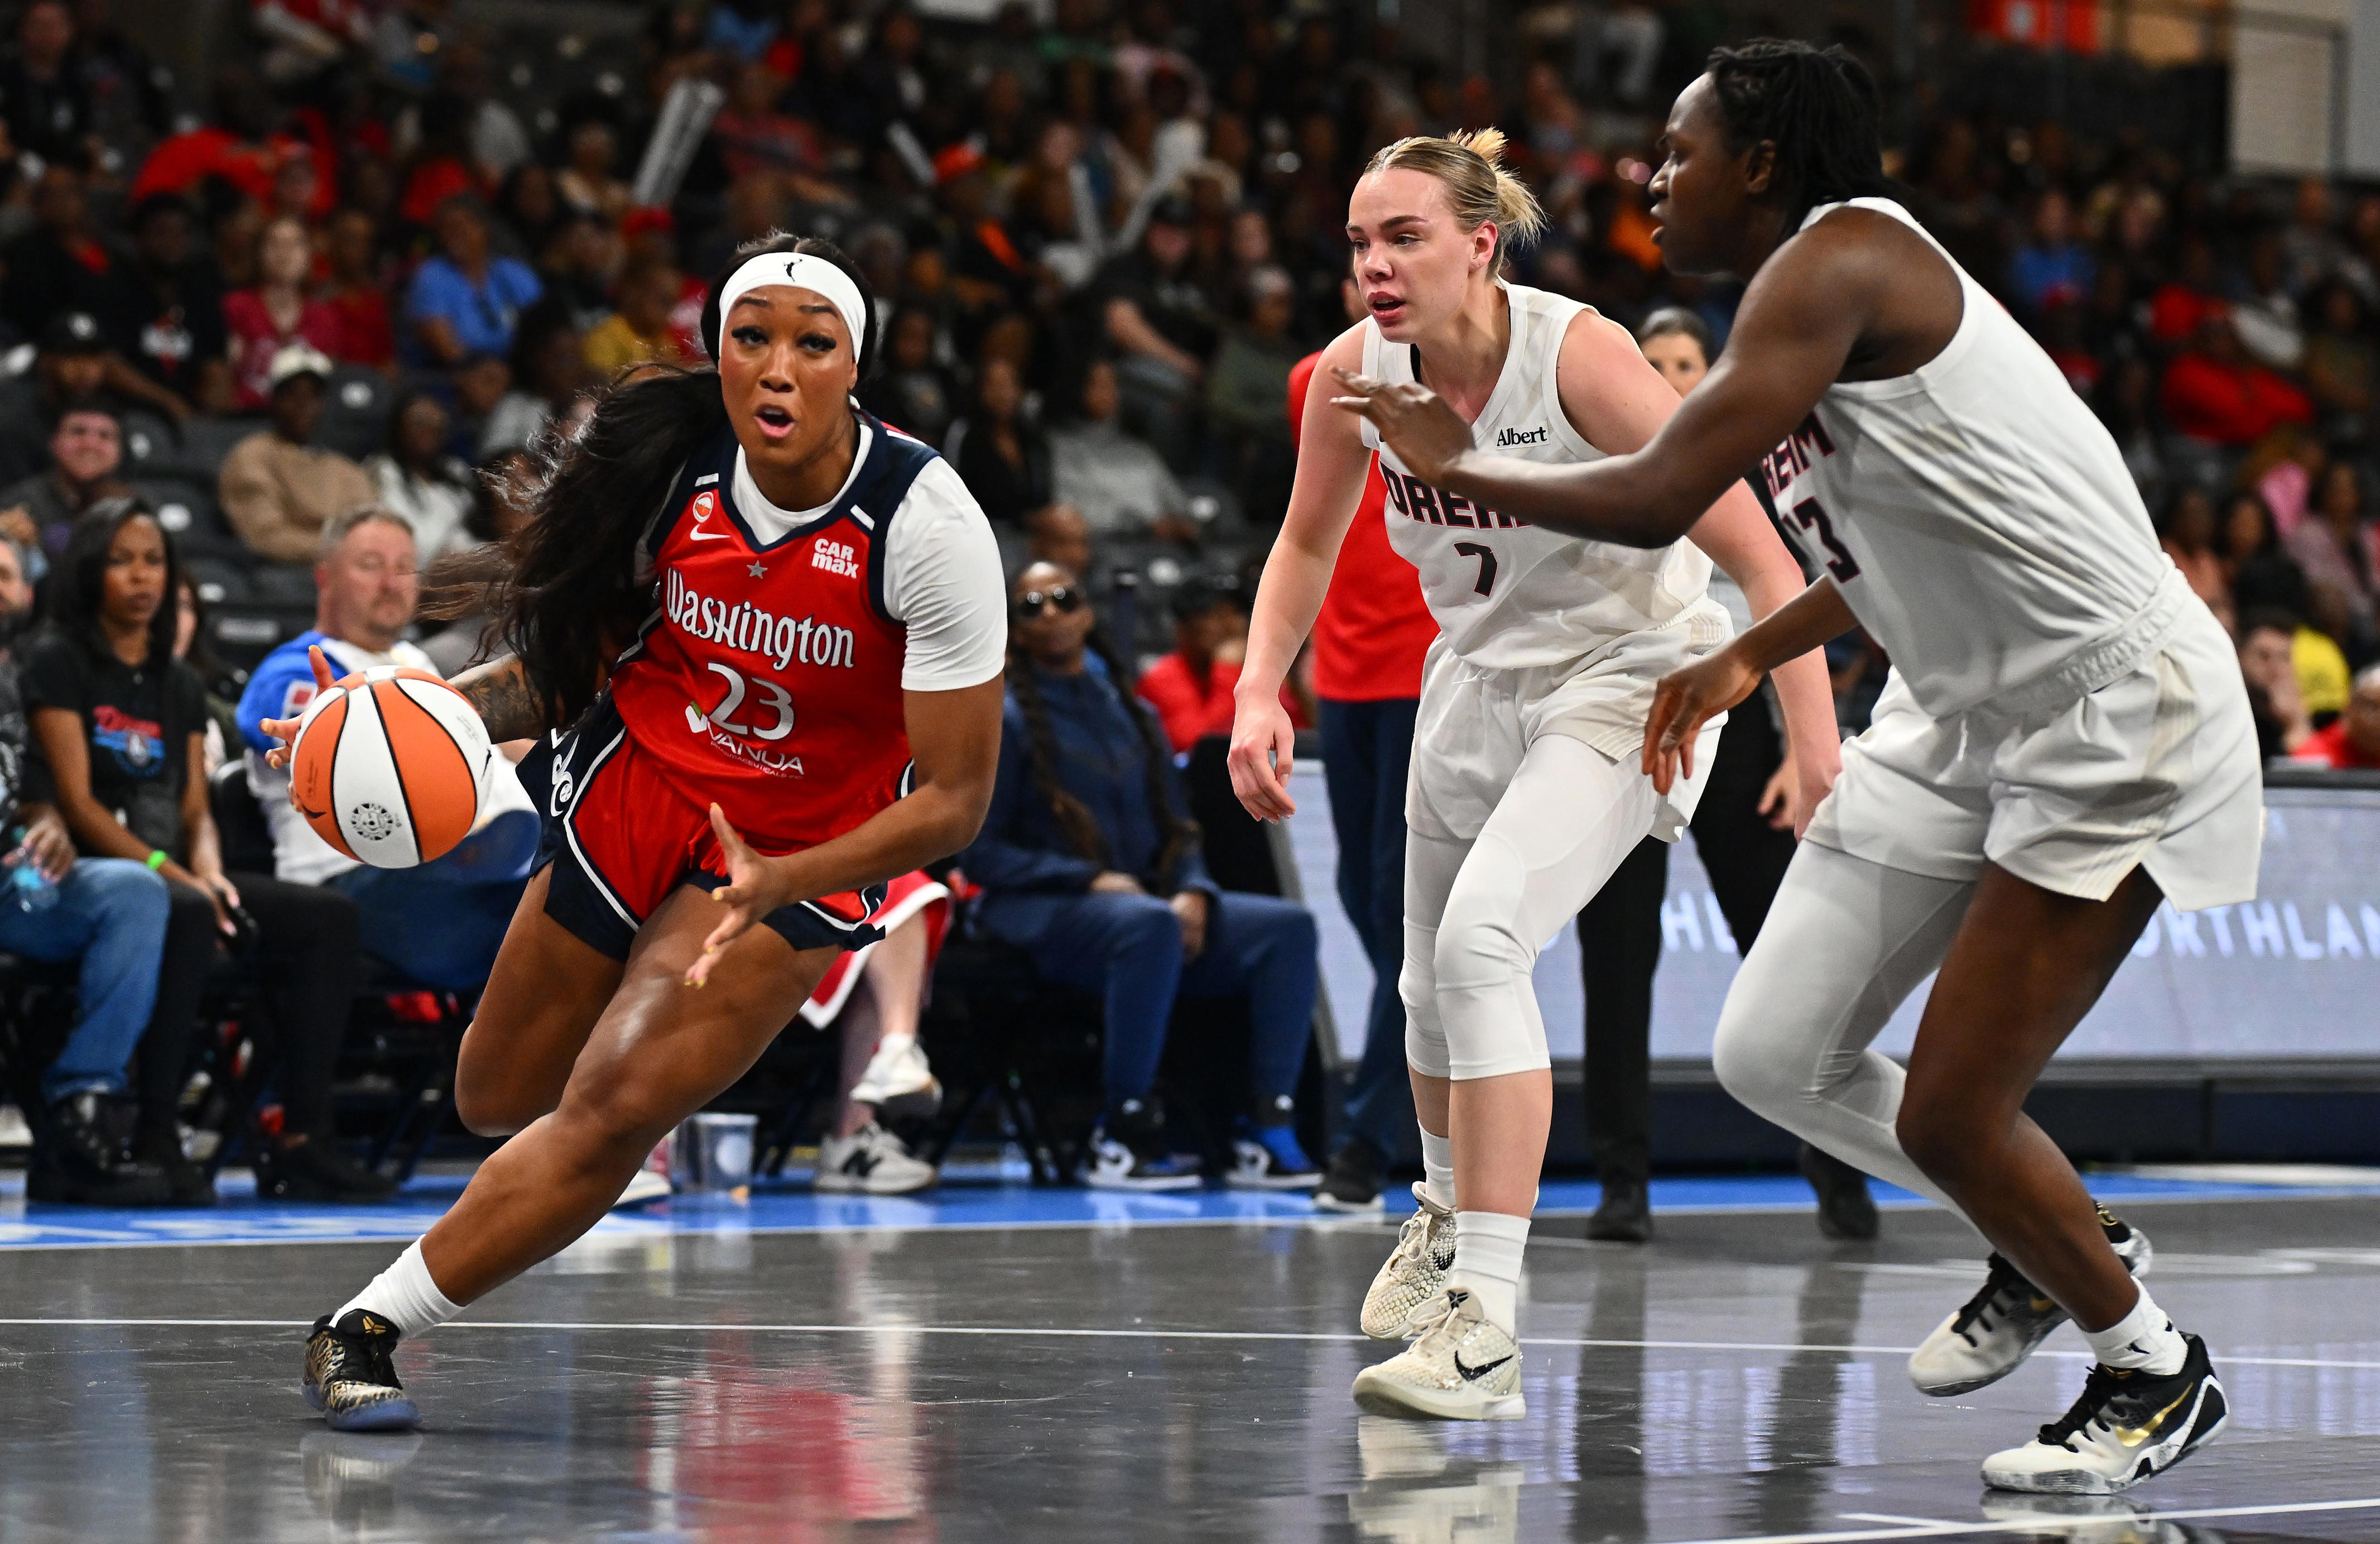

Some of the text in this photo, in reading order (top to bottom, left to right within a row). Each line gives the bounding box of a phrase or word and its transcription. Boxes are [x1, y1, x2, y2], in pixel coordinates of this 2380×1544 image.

[1496, 426, 1547, 447] Albert
[1379, 460, 1533, 529] DRE
[811, 552, 859, 579] max
[814, 538, 854, 562] CAR
[1453, 540, 1498, 597] 7
[666, 566, 854, 670] Washington
[706, 661, 795, 741] 23
